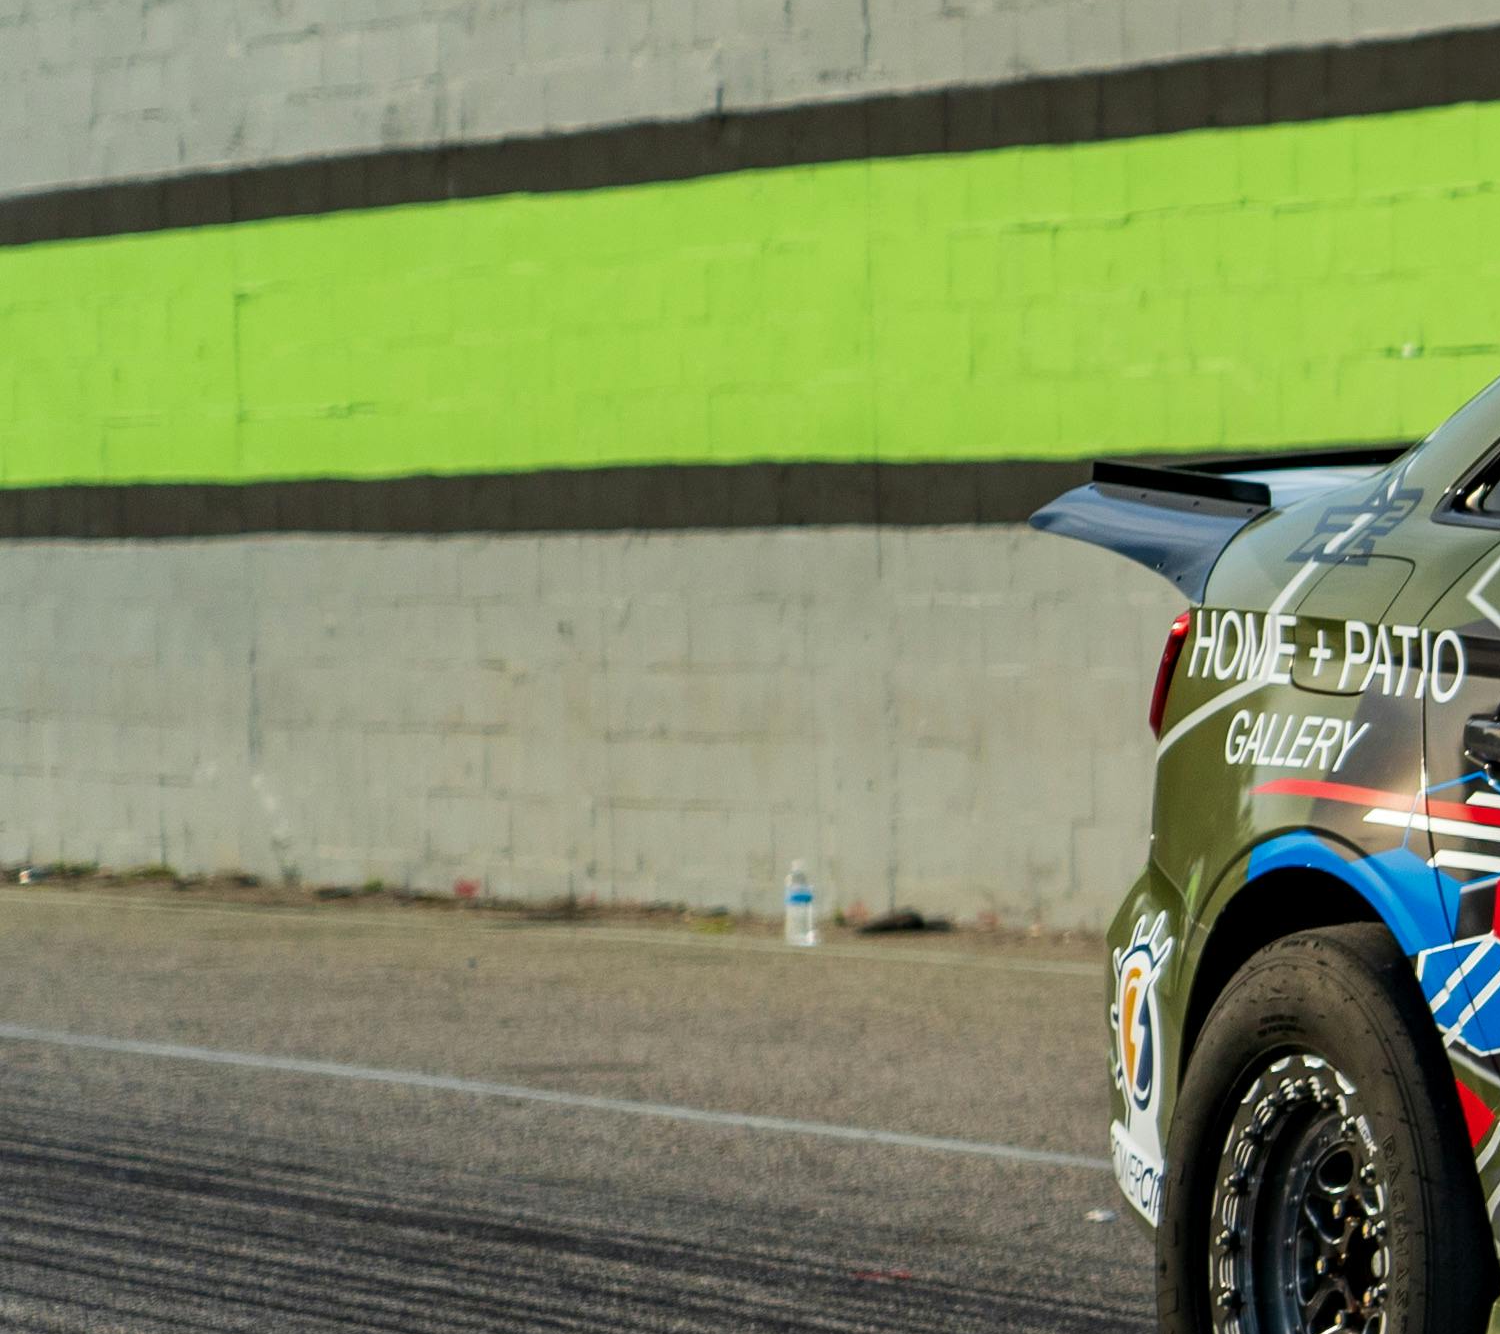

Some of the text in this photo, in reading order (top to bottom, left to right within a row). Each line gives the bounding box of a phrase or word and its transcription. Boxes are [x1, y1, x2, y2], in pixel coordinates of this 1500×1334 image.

[1187, 609, 1297, 685] HOME
[1337, 619, 1465, 703] PATIO
[1225, 709, 1371, 773] GALLERY
